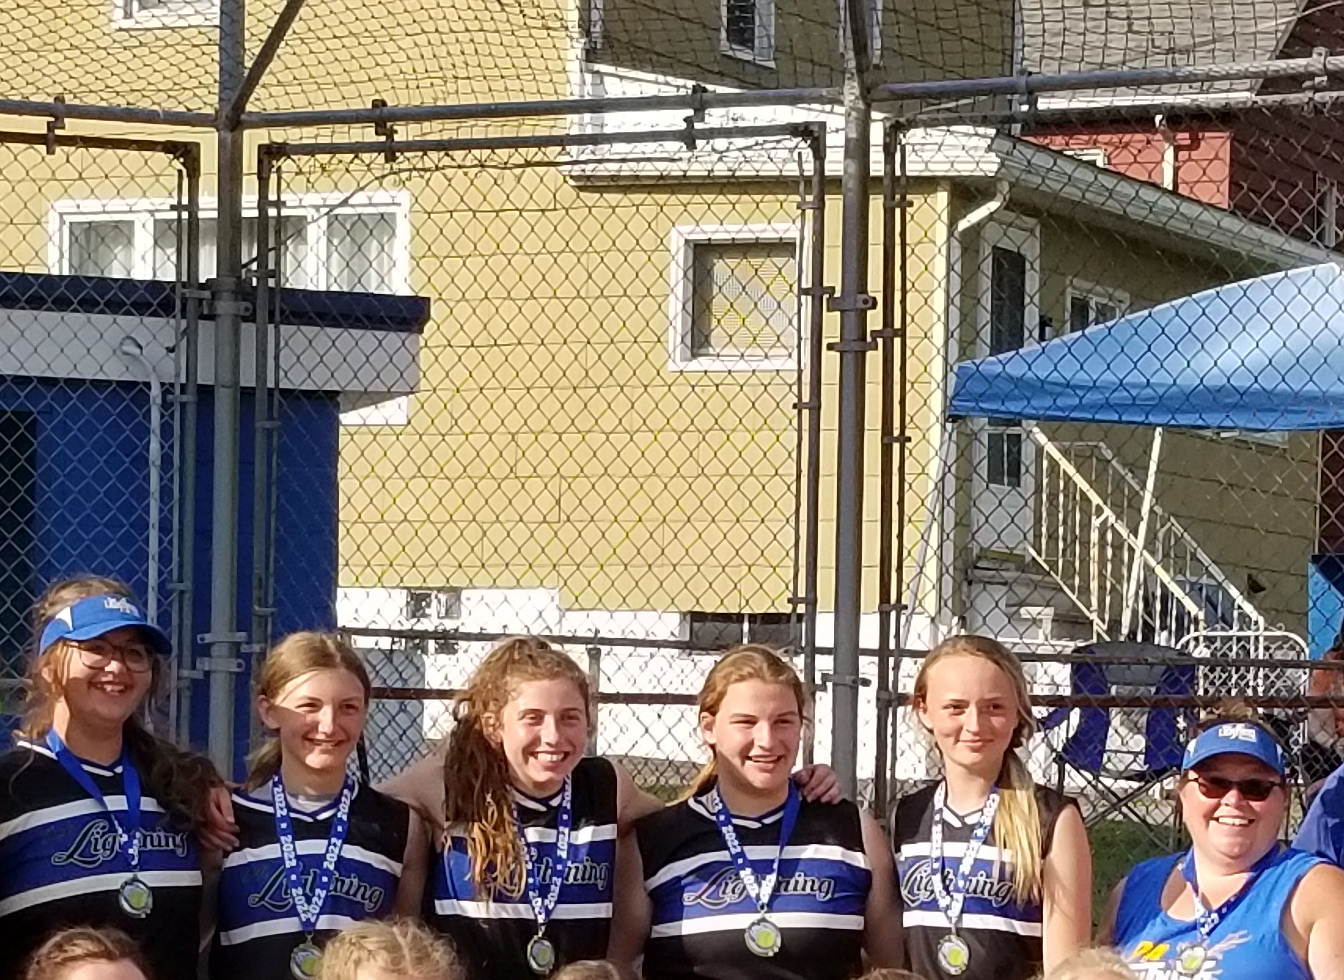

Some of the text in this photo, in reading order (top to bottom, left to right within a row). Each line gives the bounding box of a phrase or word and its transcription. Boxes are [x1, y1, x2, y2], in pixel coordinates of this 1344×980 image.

[273, 784, 287, 818] 2022
[51, 818, 188, 868] Ligning
[280, 834, 297, 868] 2022
[323, 837, 343, 871] 2022
[292, 886, 311, 922] 2022
[308, 887, 327, 923] 2022
[682, 865, 835, 909] Ligning
